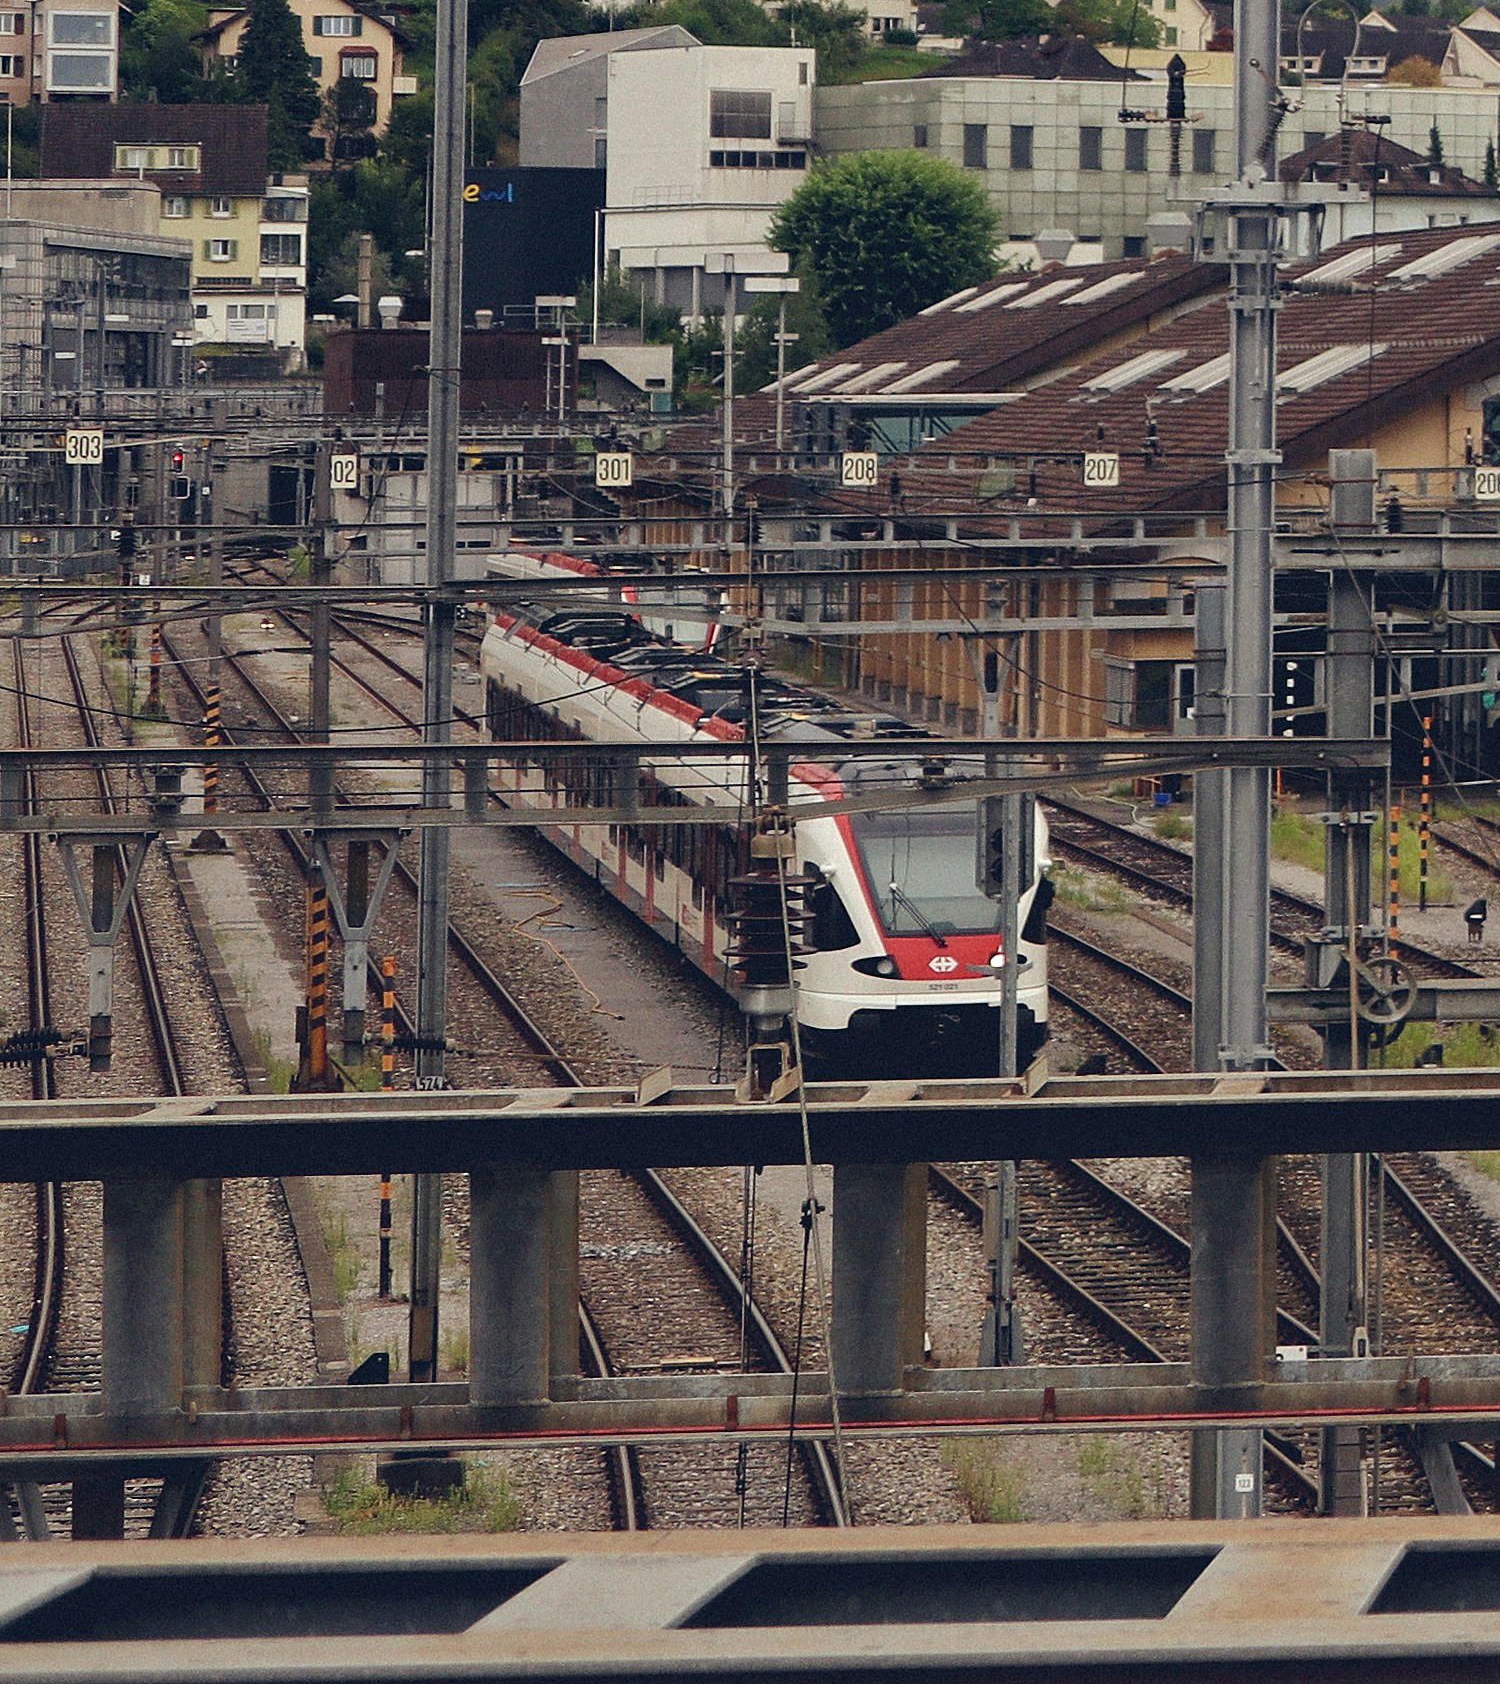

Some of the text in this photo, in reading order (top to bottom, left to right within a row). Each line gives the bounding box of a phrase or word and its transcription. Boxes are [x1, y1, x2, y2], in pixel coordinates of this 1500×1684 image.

[463, 182, 513, 203] ewl
[68, 435, 100, 458] 303
[334, 460, 355, 483] 02
[599, 458, 629, 481] 301
[844, 458, 875, 483] 208
[1086, 458, 1118, 481] 207
